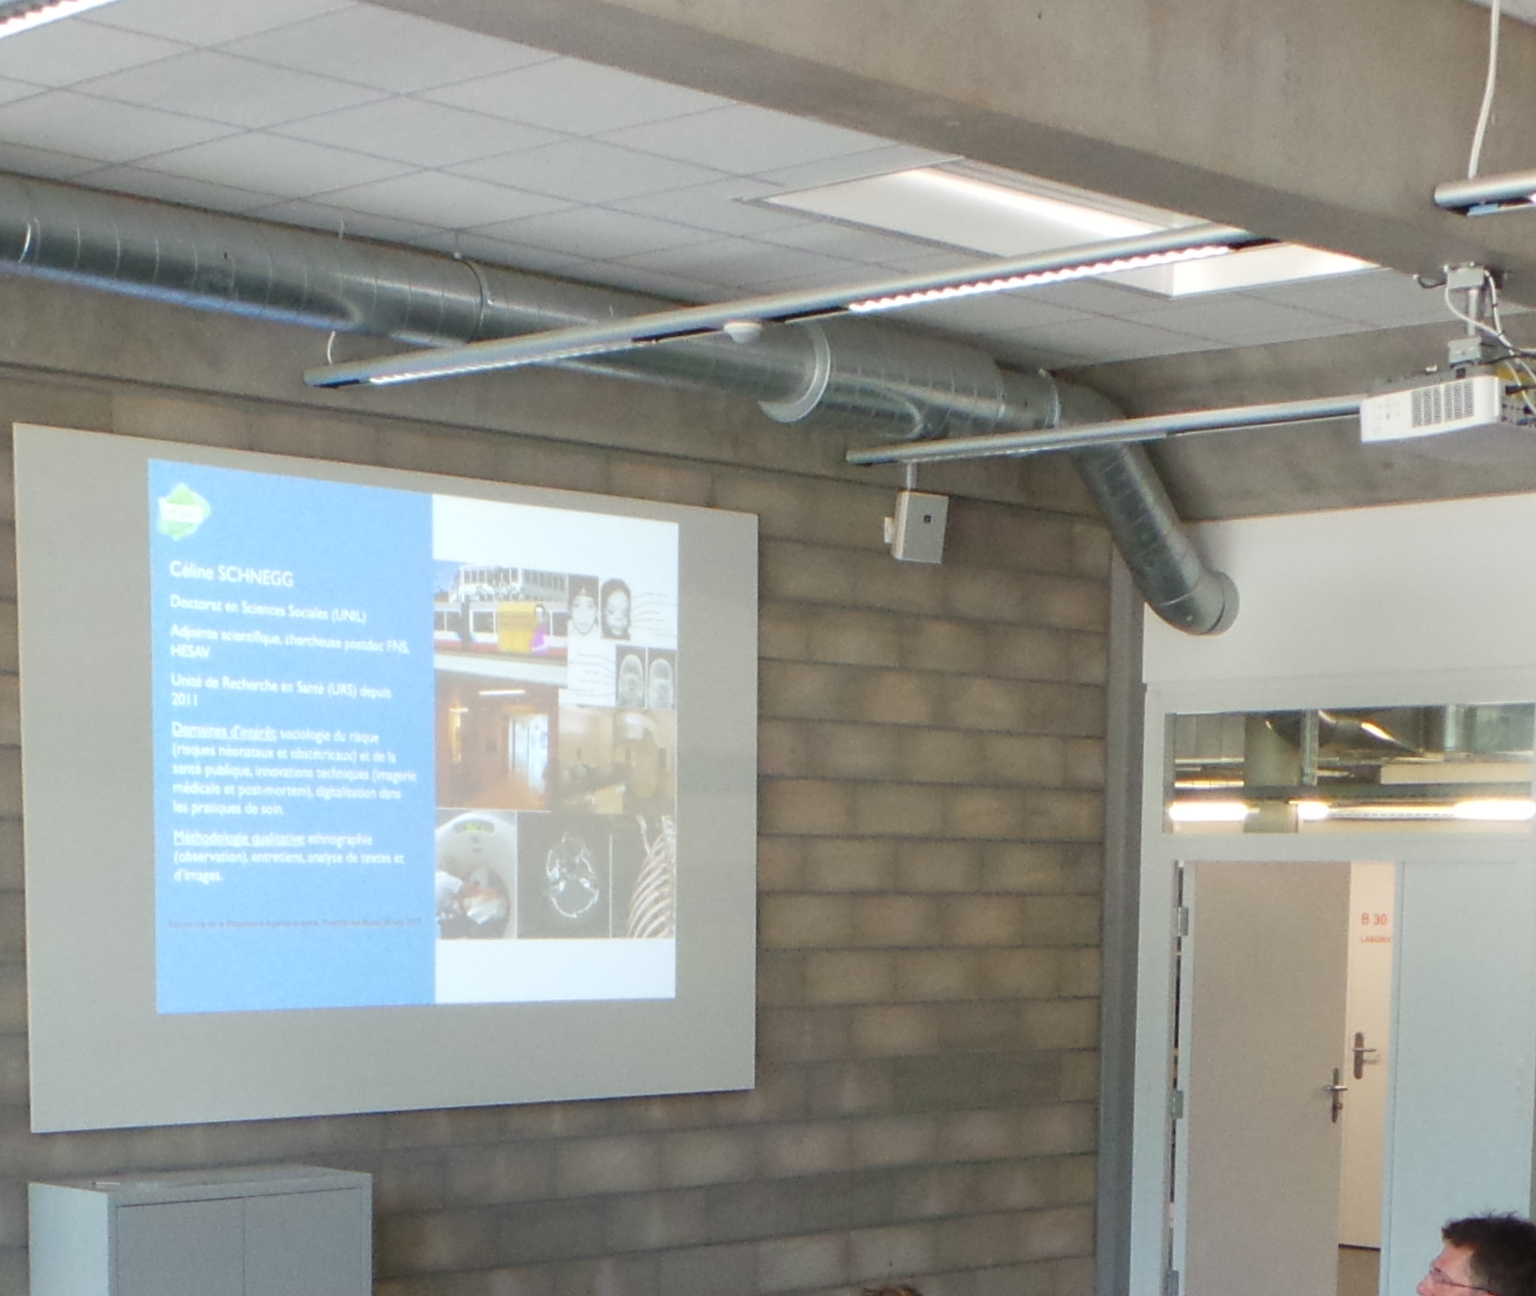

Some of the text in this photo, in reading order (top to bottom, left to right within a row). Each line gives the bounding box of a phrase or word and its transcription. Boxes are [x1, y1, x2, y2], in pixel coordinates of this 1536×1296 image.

[169, 560, 294, 587] Céline SCHNEGG
[169, 594, 367, 625] Doctorat en Sciences Sociales (UNIL)
[170, 624, 410, 654] Adjointe scientifique, chercheuse postdoc FNS,
[170, 644, 211, 659] HESAV
[170, 673, 392, 700] Unité de Recherche en Santé (URS) depuis
[170, 691, 199, 707] 2011
[171, 721, 228, 740] Domaines
[280, 728, 331, 744] sociologie
[333, 730, 346, 742] du
[349, 732, 380, 746] risque
[172, 742, 216, 759] (risques
[277, 749, 289, 760] et
[359, 751, 370, 762] et
[372, 751, 385, 763] de
[387, 750, 396, 763] la
[172, 762, 202, 775] santé
[255, 765, 313, 779] innovations
[316, 767, 369, 782] techniques
[172, 781, 221, 796] médicale
[223, 784, 236, 795] et
[379, 788, 402, 800] dans
[173, 799, 188, 814] les
[191, 802, 242, 817] pratiques
[244, 802, 259, 815] de
[308, 832, 373, 848] ethnographie
[307, 852, 343, 866] analyse
[345, 852, 359, 864] de
[361, 853, 392, 864] textes
[393, 854, 405, 864] et
